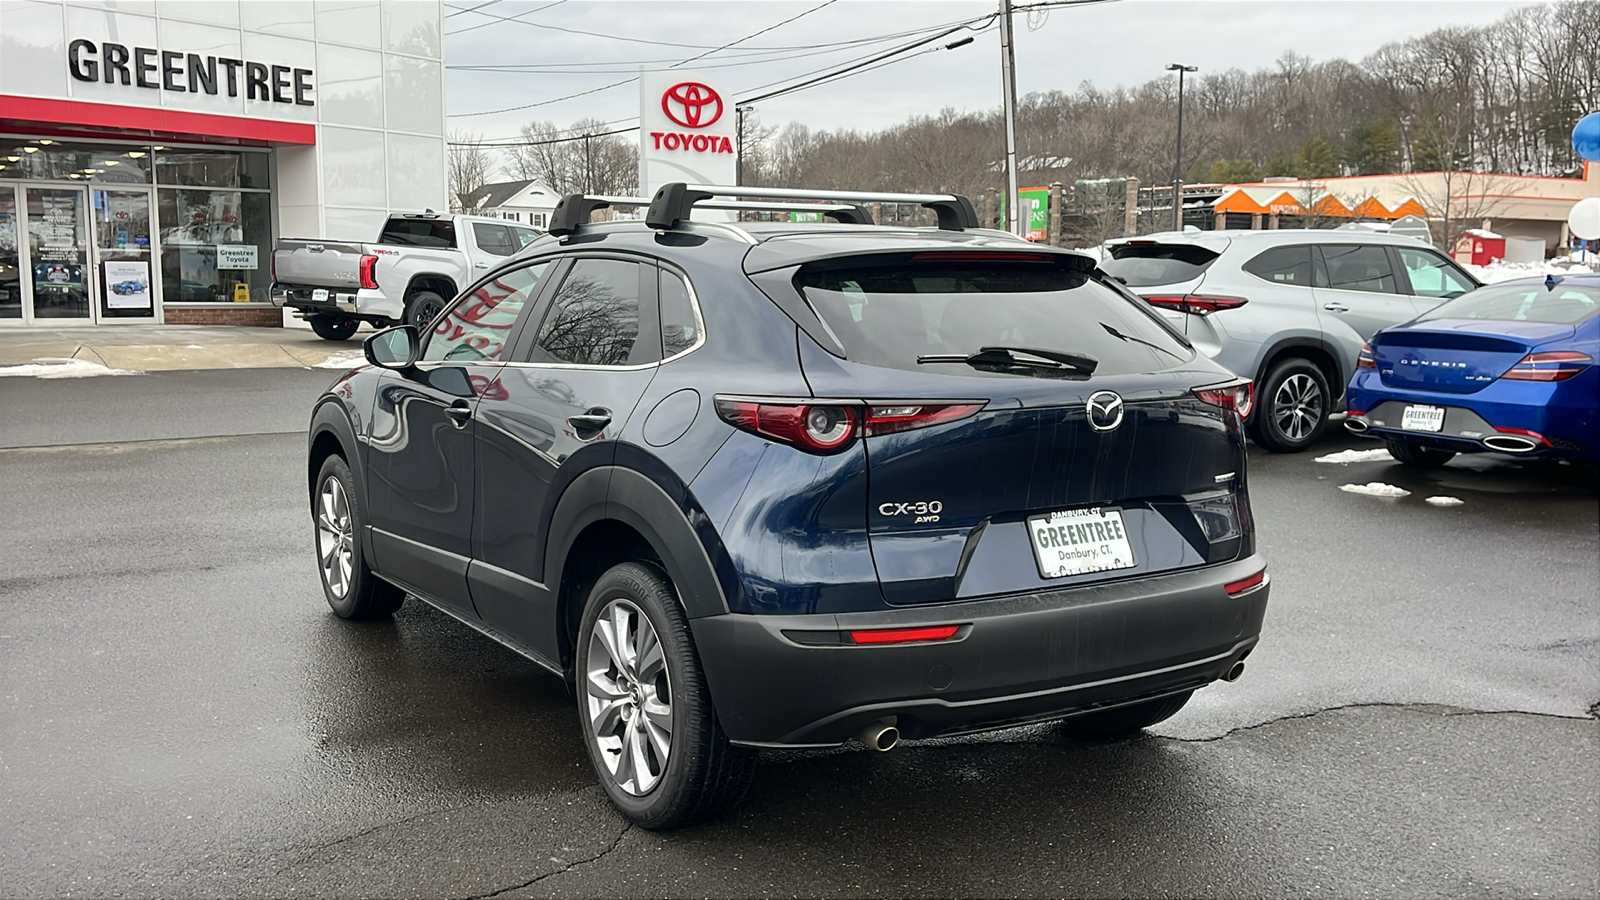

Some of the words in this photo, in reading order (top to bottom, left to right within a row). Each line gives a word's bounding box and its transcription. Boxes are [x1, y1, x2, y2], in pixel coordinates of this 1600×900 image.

[68, 38, 315, 107] GREENTREE
[650, 132, 733, 154] TOYOTA
[1400, 359, 1467, 368] GENESIS
[1405, 410, 1441, 420] GREENTREE
[878, 500, 943, 516] CX-30
[1090, 507, 1101, 516] CT
[914, 515, 940, 524] AWD
[1037, 519, 1123, 549] GREENTREE
[1058, 546, 1099, 561] Danbury,
[1100, 544, 1113, 555] CT.
